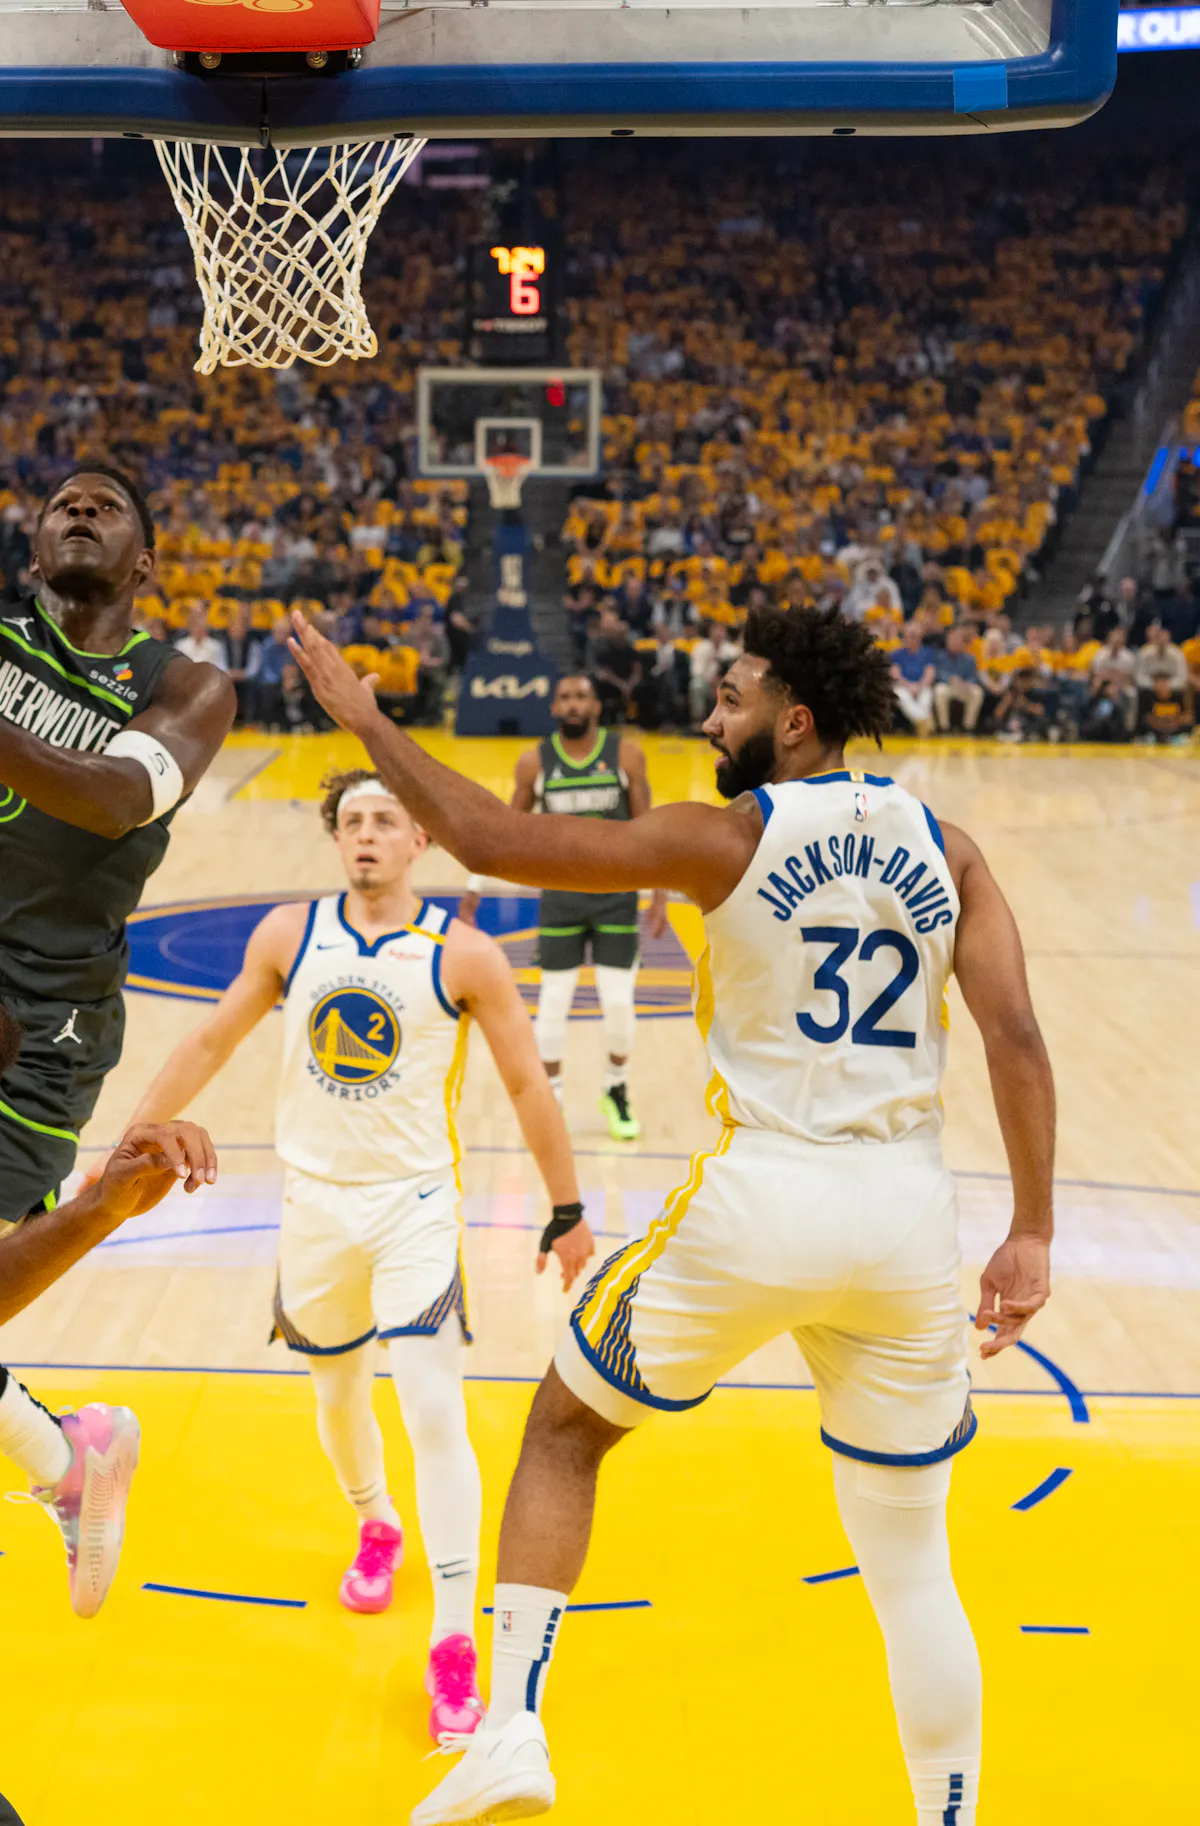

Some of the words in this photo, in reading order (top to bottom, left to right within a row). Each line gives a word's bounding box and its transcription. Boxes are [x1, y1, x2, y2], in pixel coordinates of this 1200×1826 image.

[510, 271, 540, 315] 6
[89, 669, 138, 700] sezzle
[757, 832, 953, 934] JACKSON-DAVIS
[310, 975, 365, 1001] GOLDEN
[372, 981, 405, 1012] STATE
[796, 926, 919, 1049] 32
[366, 1011, 386, 1041] 2
[306, 1060, 403, 1101] WARRIORS
